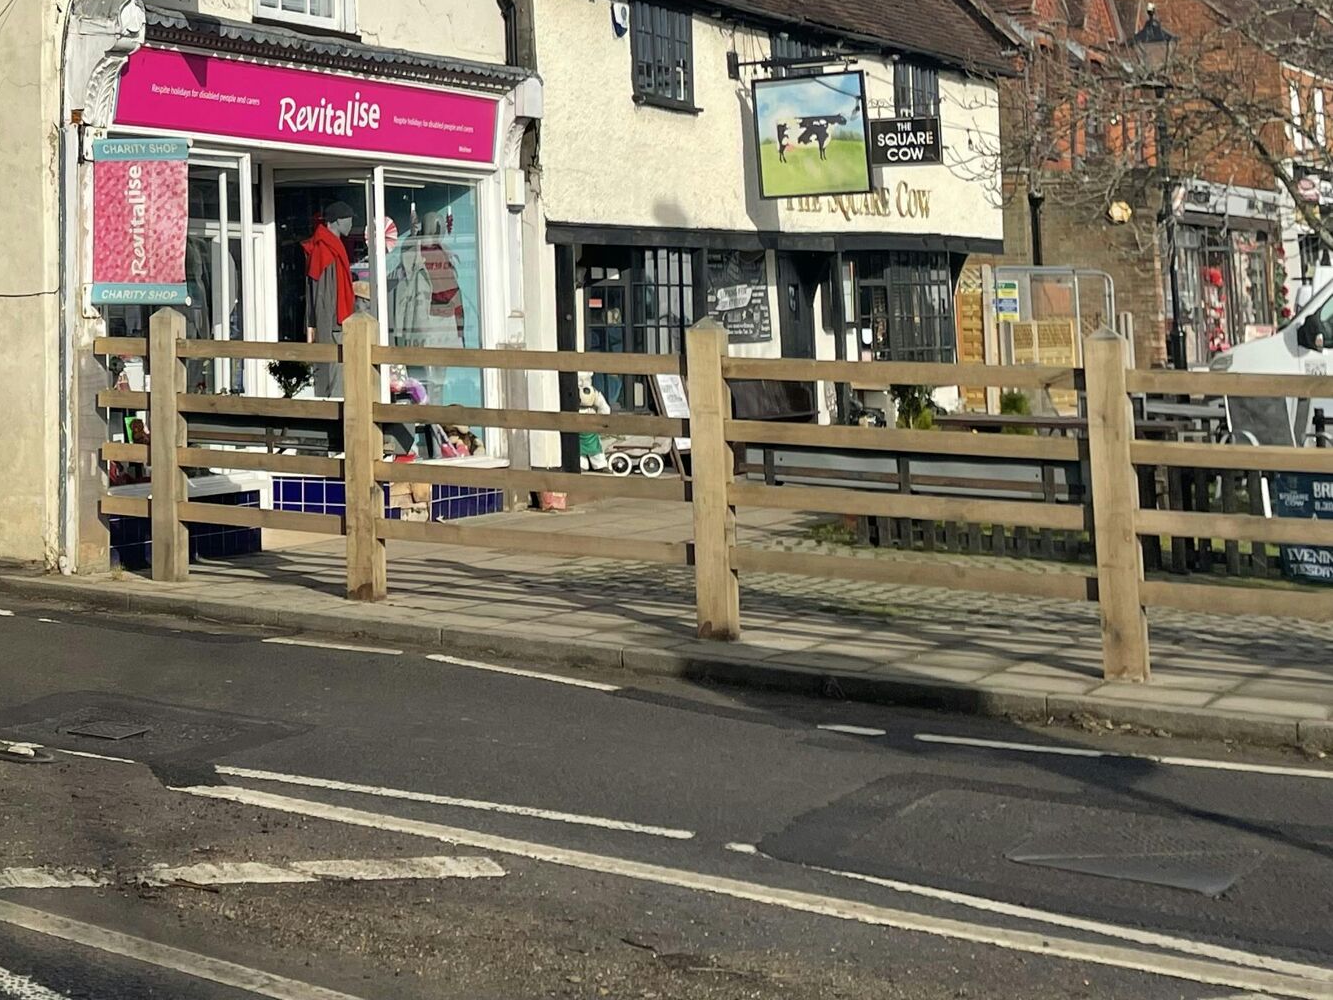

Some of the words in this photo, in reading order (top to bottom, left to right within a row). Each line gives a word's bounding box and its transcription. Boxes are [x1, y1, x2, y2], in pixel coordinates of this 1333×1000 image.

[151, 83, 170, 95] Respite
[171, 86, 191, 98] holidays
[191, 88, 199, 97] for
[199, 90, 219, 101] disabled
[219, 94, 236, 103] people
[236, 96, 246, 104] and
[278, 91, 381, 137] Revitalise
[897, 122, 912, 131] THE
[877, 131, 934, 147] SQUARE
[102, 143, 146, 154] CHARITY
[148, 144, 178, 154] SHOP
[887, 147, 924, 161] COW
[896, 180, 932, 218] COW
[124, 165, 147, 276] Revitalise
[101, 289, 146, 300] CHARITY
[148, 290, 178, 300] SHOP
